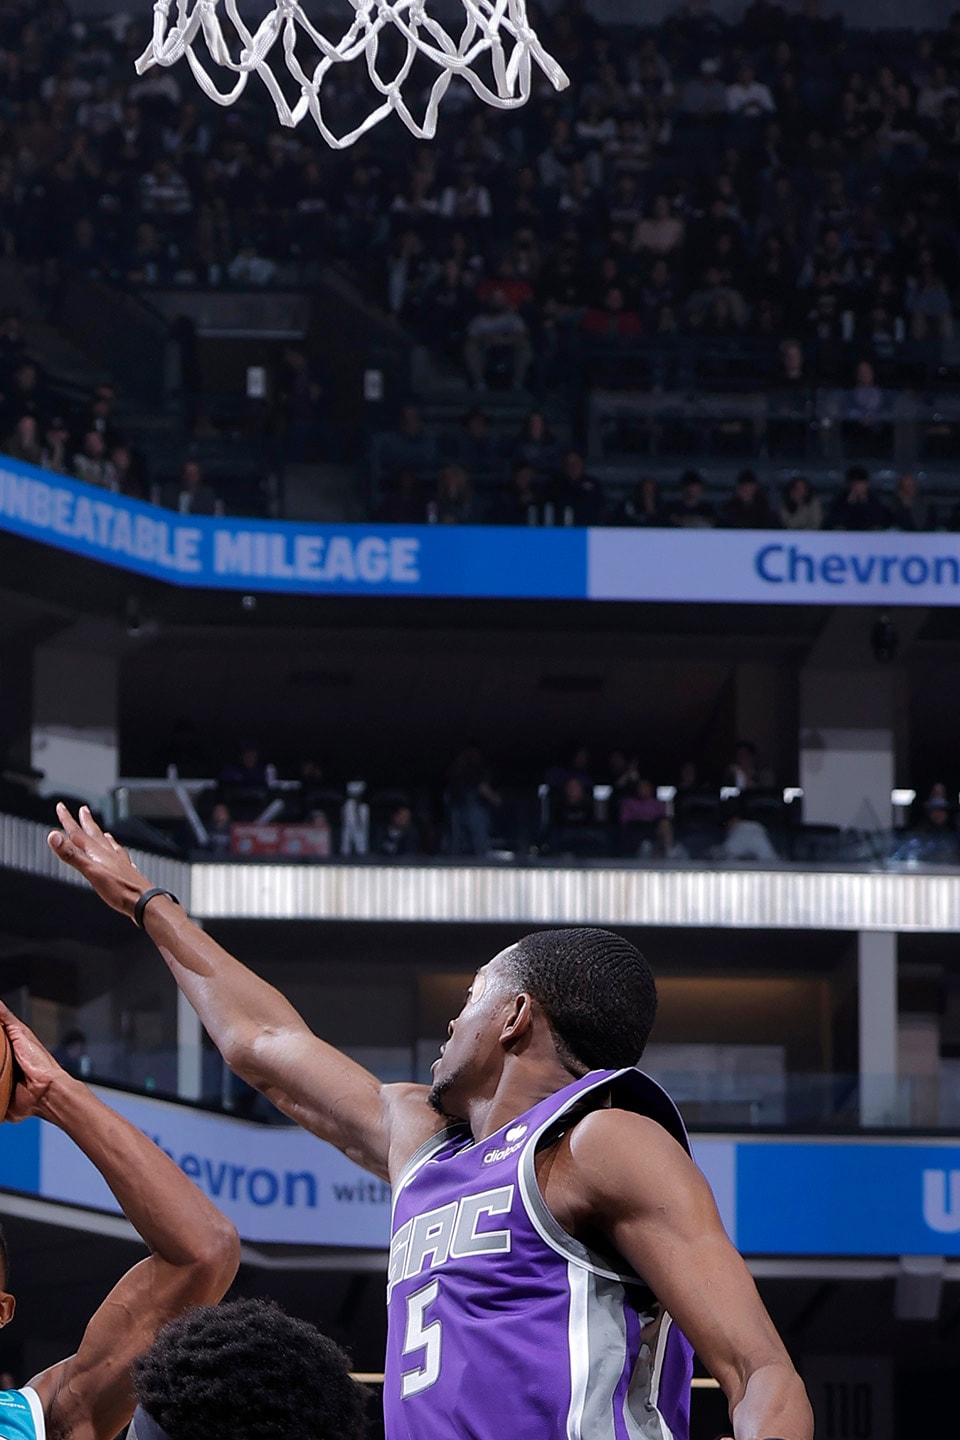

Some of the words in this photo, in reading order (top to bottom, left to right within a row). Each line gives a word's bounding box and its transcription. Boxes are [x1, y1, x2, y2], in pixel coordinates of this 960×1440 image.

[213, 529, 420, 583] MILEAGE
[755, 543, 960, 586] Chevron
[400, 1277, 442, 1400] 5
